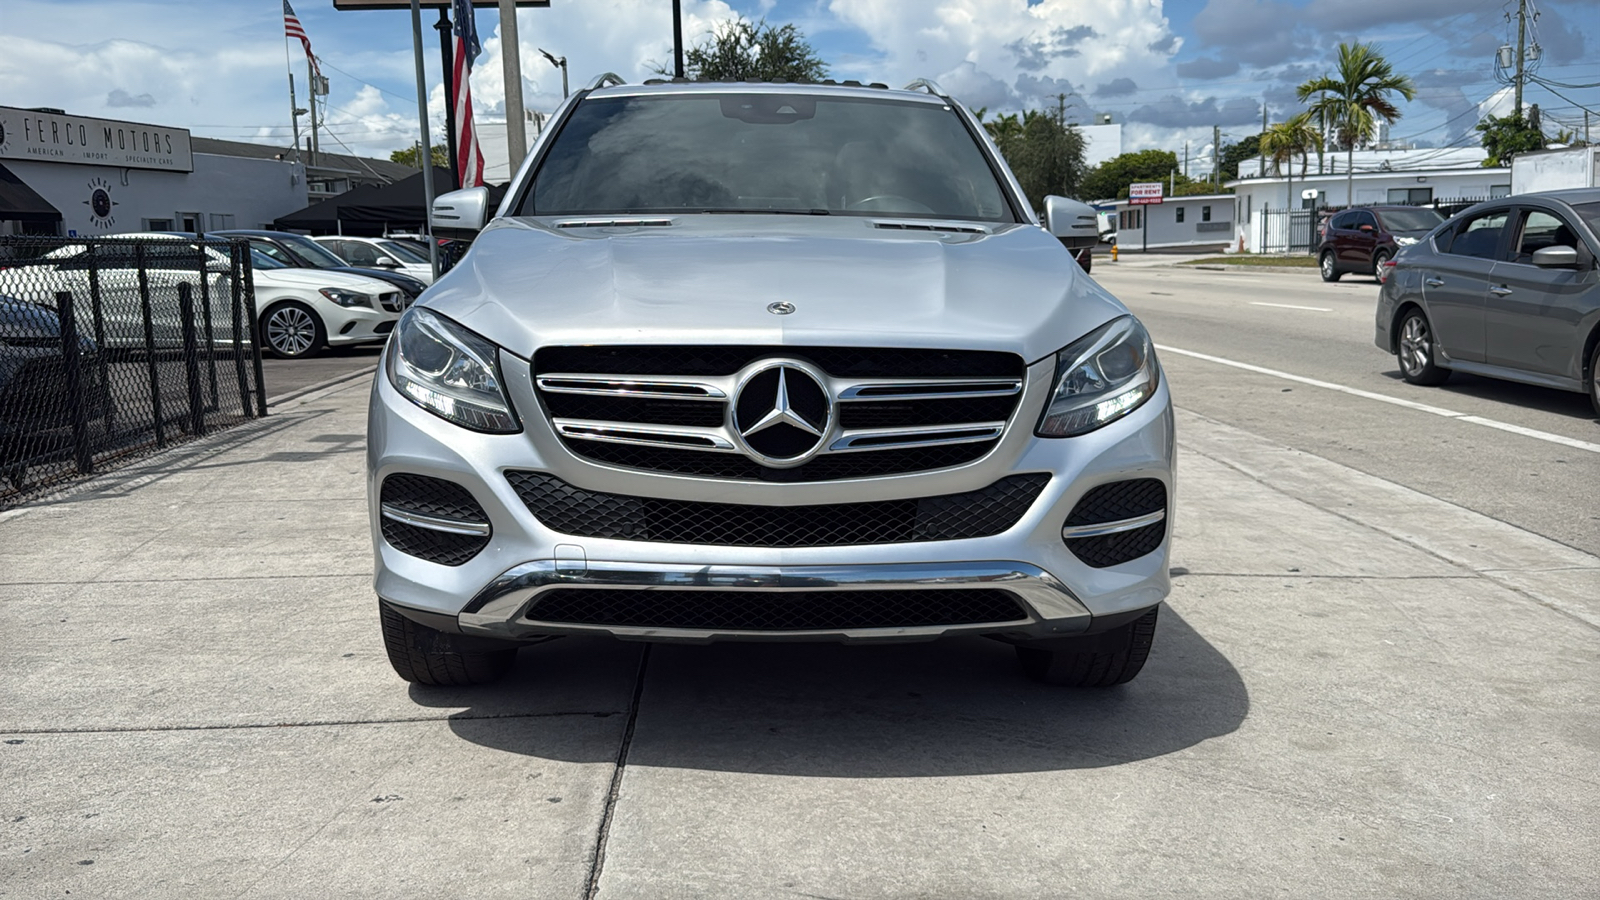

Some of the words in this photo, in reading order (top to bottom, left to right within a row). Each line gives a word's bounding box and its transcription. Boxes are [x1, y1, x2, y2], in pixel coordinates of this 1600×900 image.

[24, 118, 87, 147] FERCO
[104, 127, 173, 155] MOTORS
[27, 149, 64, 157] AMERICAN
[83, 152, 108, 160] IMPORT
[125, 155, 157, 164] SPECIALTY
